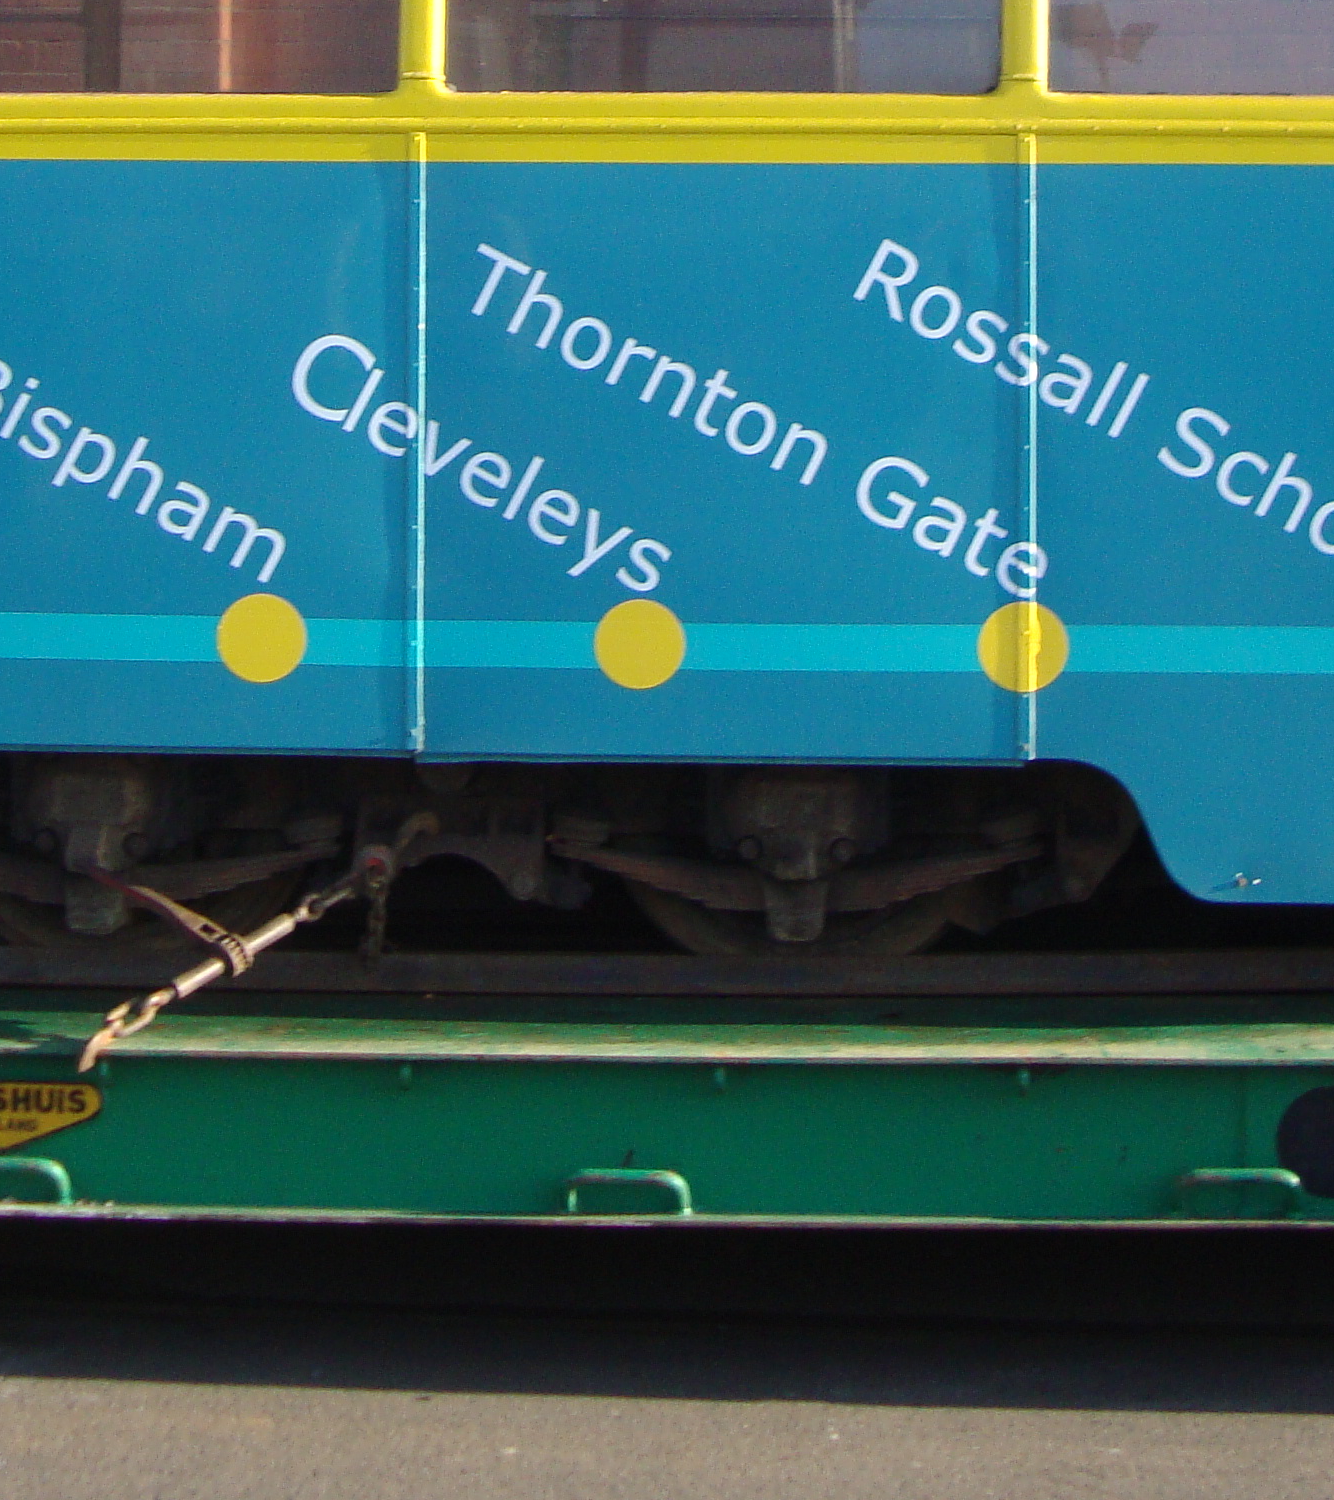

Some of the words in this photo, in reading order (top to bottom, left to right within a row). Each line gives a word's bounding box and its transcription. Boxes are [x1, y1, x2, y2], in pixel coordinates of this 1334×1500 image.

[290, 334, 673, 592] Cleveleys
[471, 243, 829, 486] Thornton
[855, 455, 1049, 598] Gate
[853, 238, 1151, 438] Rossall
